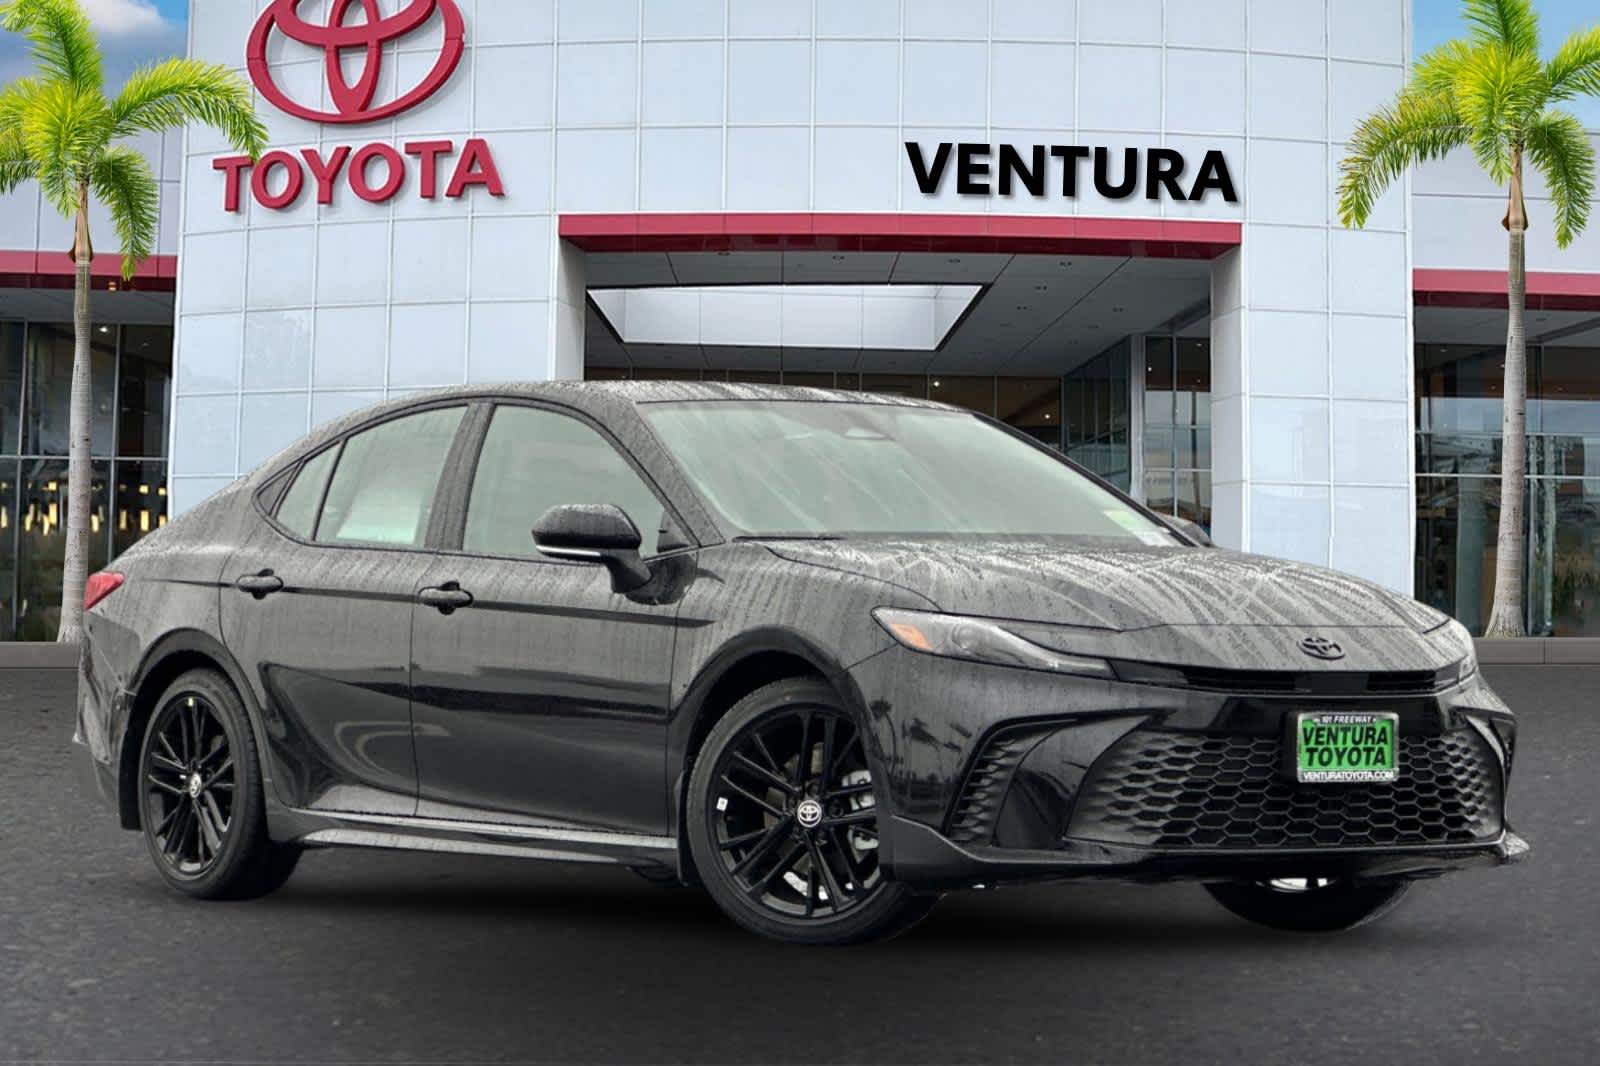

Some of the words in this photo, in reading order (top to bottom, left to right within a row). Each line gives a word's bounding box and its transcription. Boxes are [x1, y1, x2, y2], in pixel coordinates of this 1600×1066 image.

[212, 138, 505, 212] TOYOTA
[904, 141, 1239, 203] VENTURA
[1334, 715, 1371, 723] FREEWAY
[1303, 726, 1388, 745] VENTURA
[1305, 747, 1386, 766] TOYOTA
[1303, 771, 1394, 780] VENTURATOYOTA.COM
